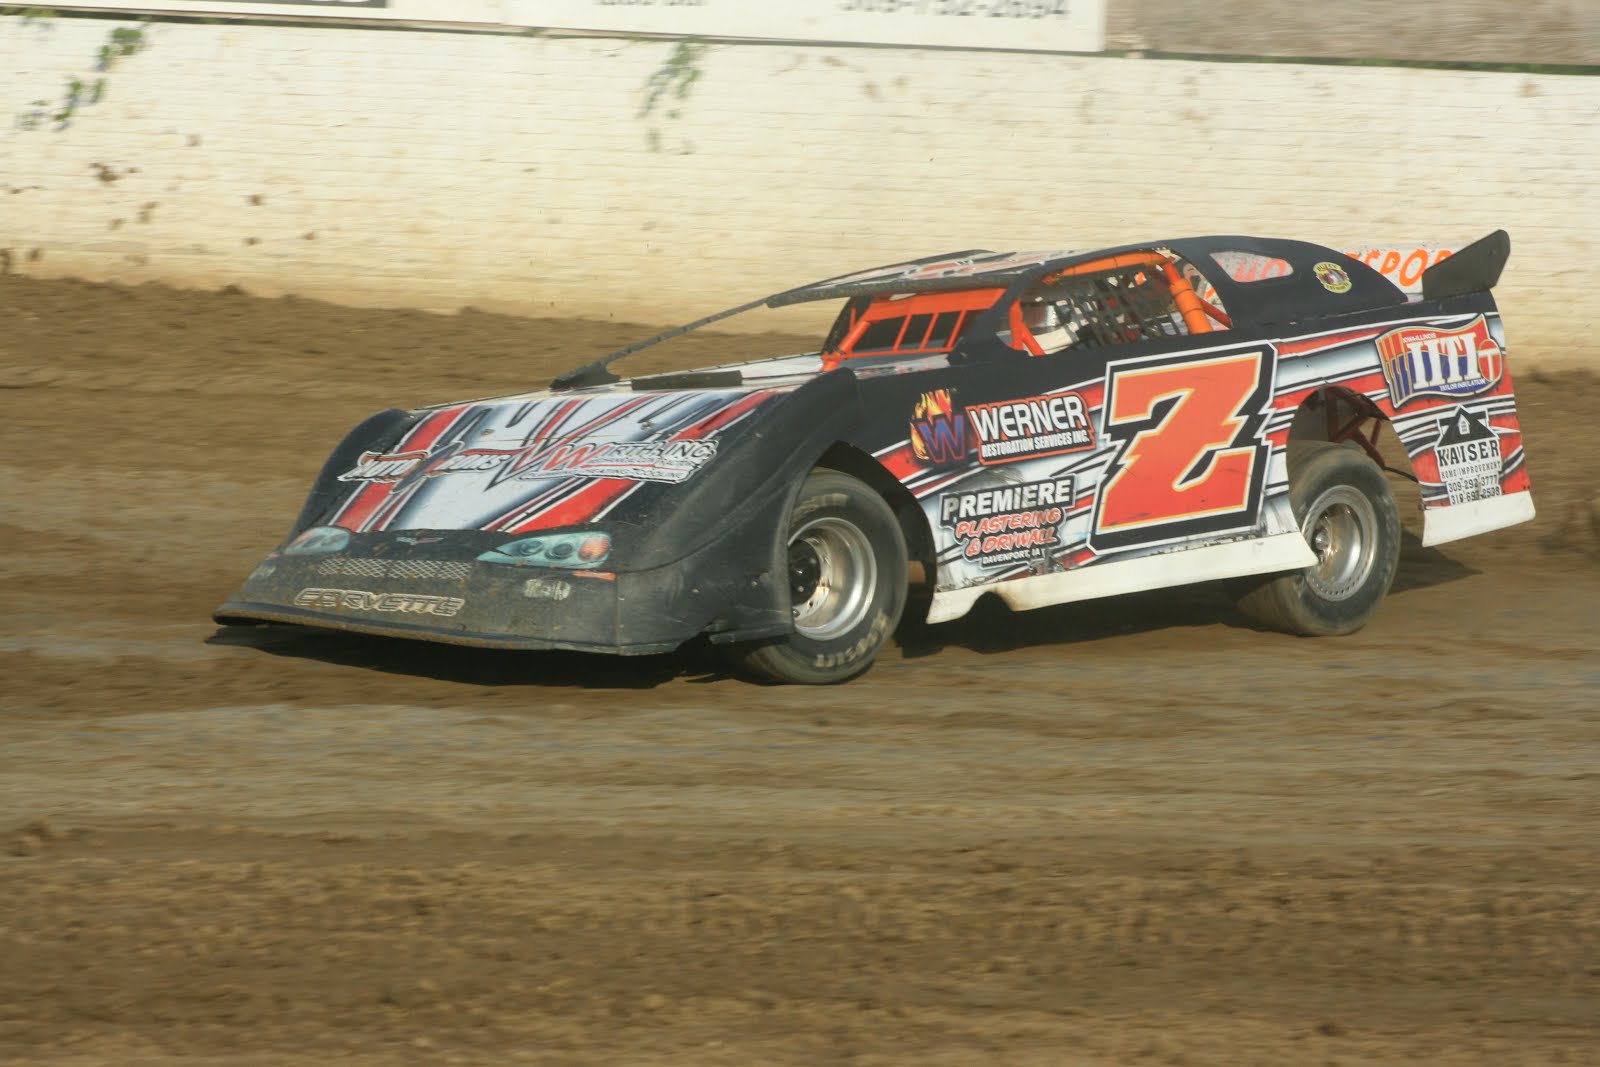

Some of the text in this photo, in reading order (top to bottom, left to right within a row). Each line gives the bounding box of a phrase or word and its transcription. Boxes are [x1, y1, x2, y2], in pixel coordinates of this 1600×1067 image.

[970, 395, 1087, 441] WERNER
[981, 437, 1034, 457] RESTORATION
[1034, 432, 1073, 450] SERVICES
[1437, 440, 1499, 467] KAISER
[1441, 461, 1501, 479] HOME IMPROVEMENT
[942, 479, 1072, 522] PREMIERE
[956, 508, 1062, 538] PLASTERING
[966, 527, 1057, 556] & DRYWALL
